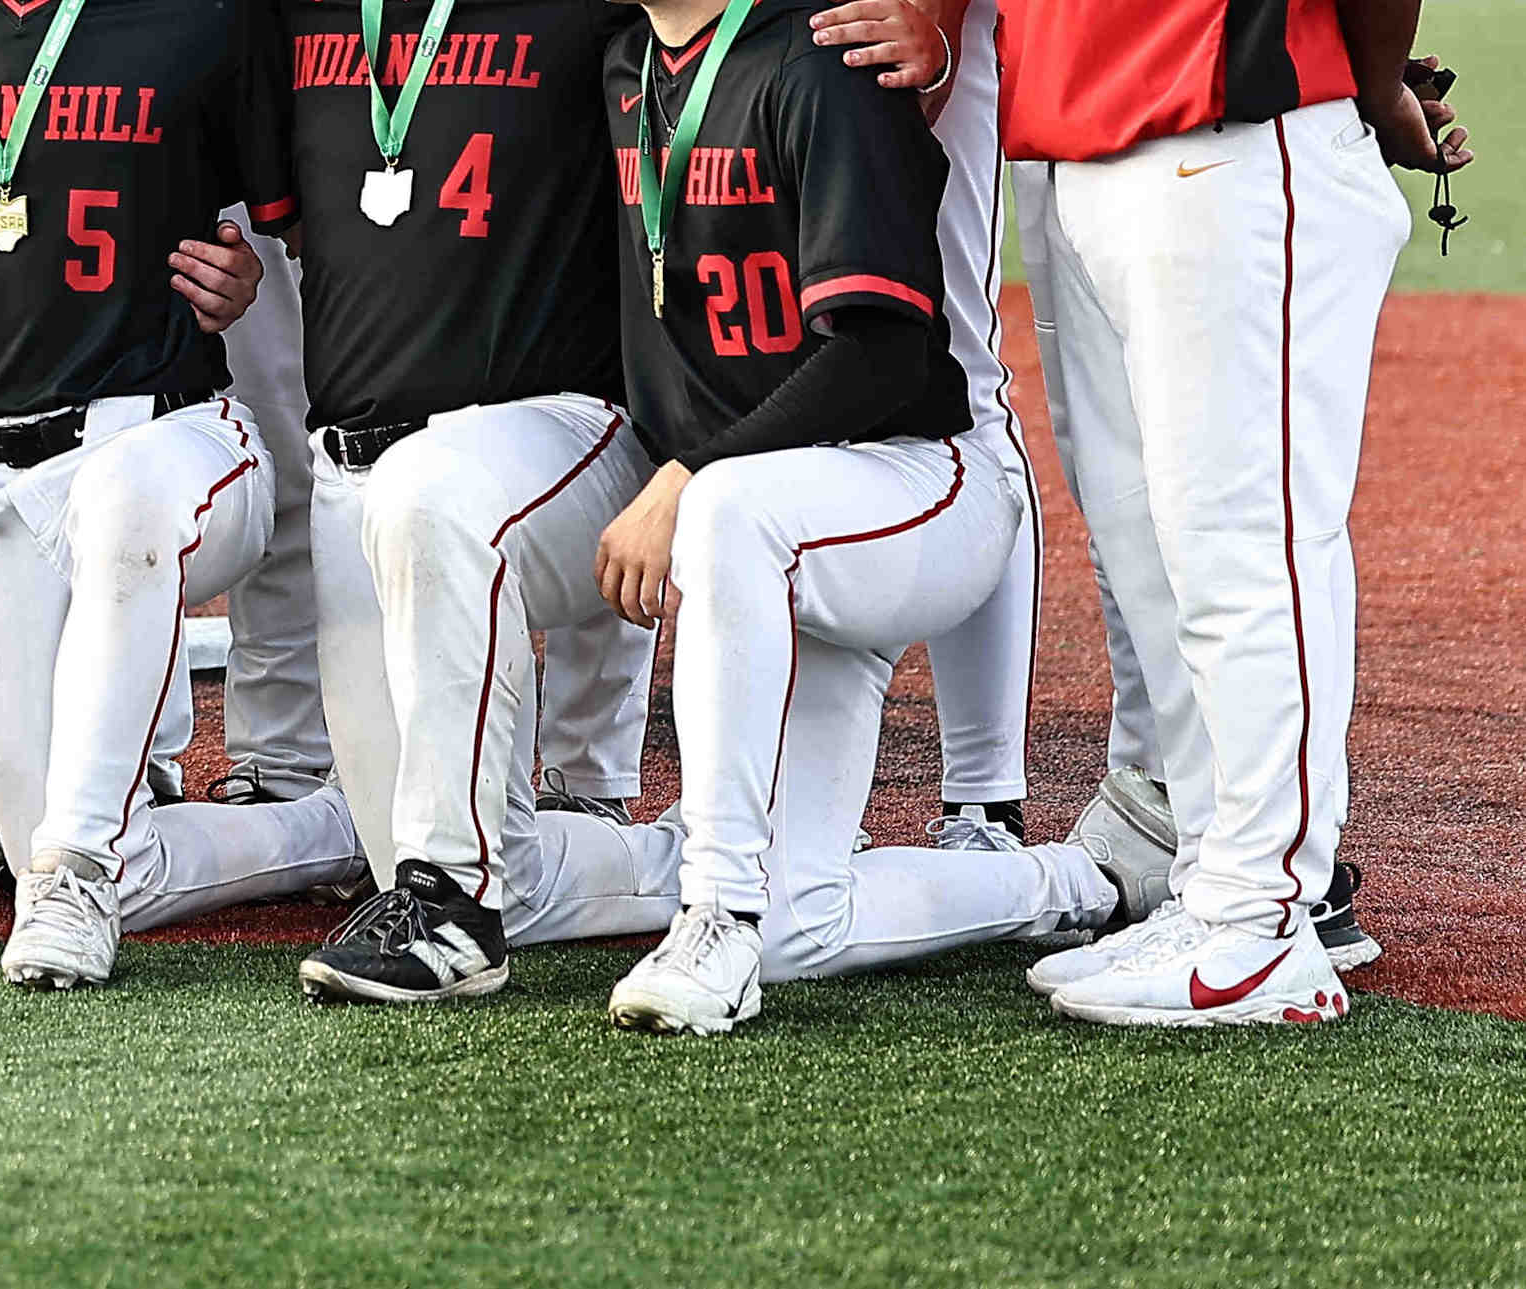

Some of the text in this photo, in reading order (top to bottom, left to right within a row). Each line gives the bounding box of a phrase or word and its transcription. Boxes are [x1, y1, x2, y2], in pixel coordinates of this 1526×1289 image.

[426, 34, 540, 89] HILL
[43, 85, 162, 143] HILL
[439, 133, 494, 238] 4
[686, 148, 775, 206] HILL
[66, 189, 119, 292] 5
[697, 251, 804, 356] 20
